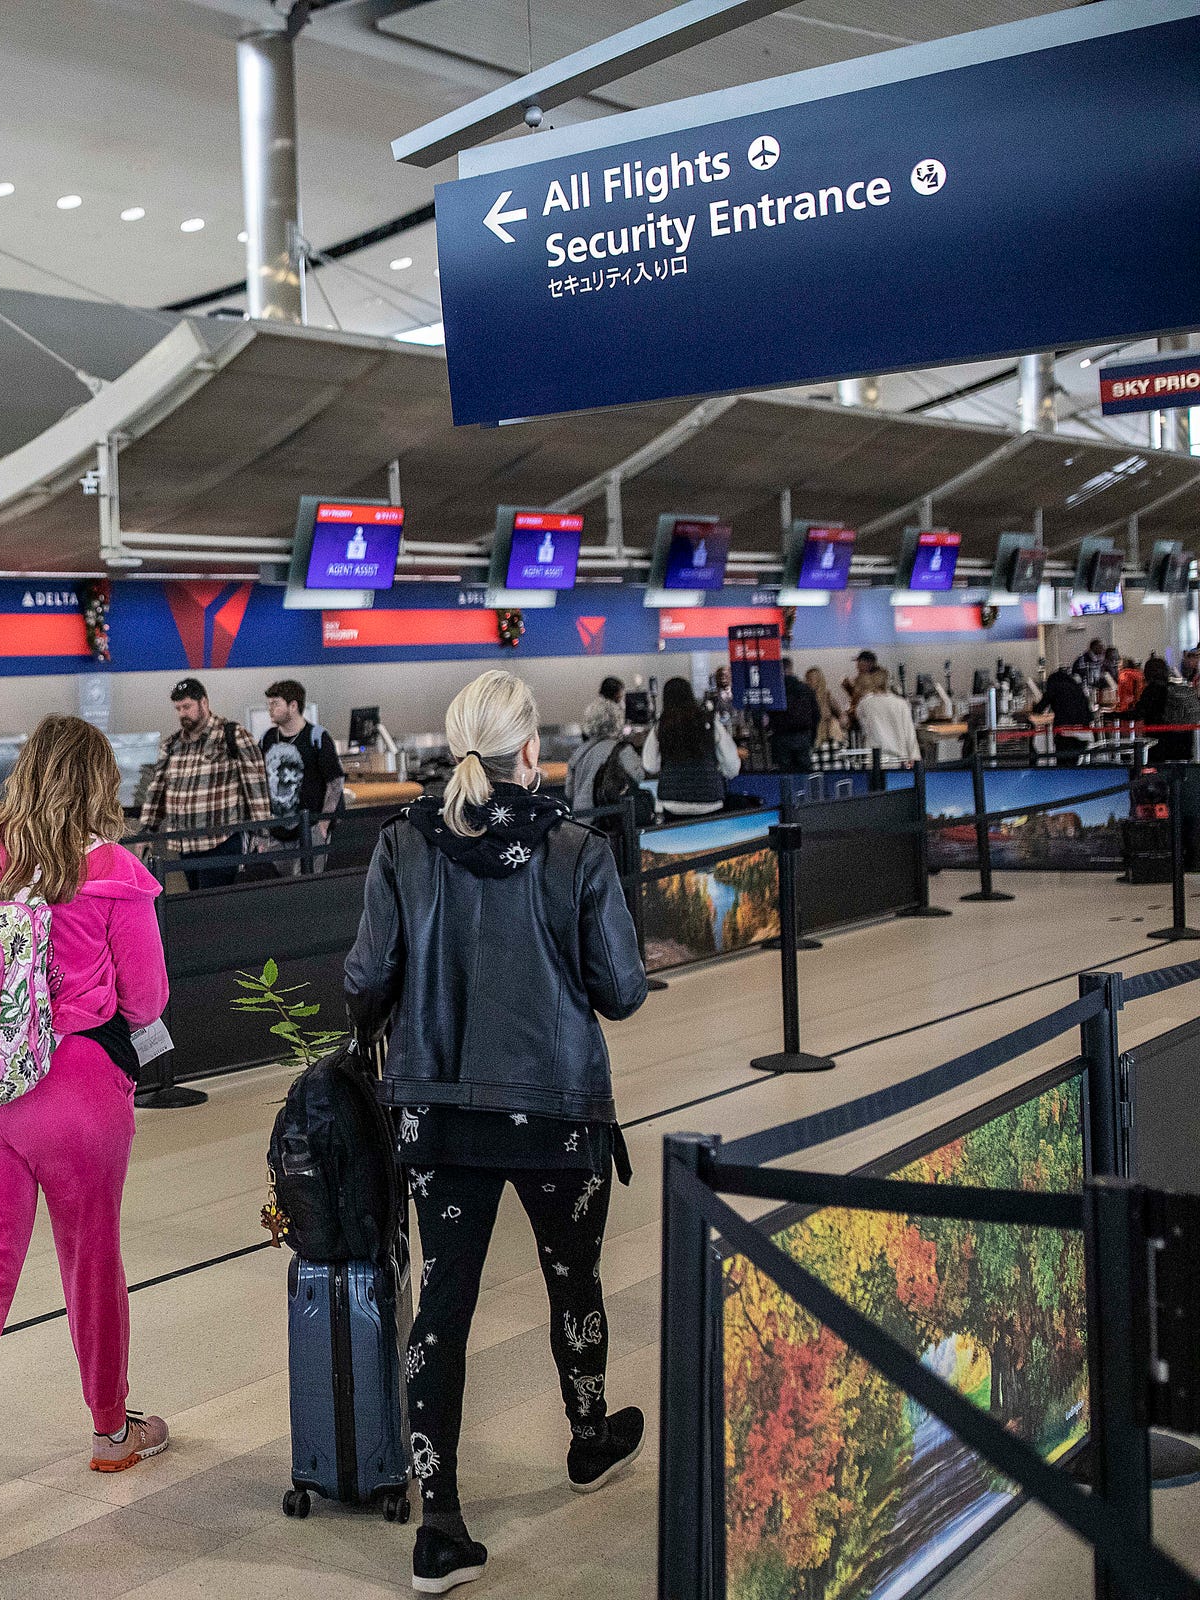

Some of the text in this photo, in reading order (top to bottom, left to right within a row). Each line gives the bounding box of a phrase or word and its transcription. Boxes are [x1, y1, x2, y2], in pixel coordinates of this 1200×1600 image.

[542, 151, 731, 217] All Flights
[545, 177, 892, 268] Security Entrance
[547, 255, 688, 298] セキュリティ入り口
[1112, 379, 1150, 398] SKY
[35, 591, 79, 606] DELTA
